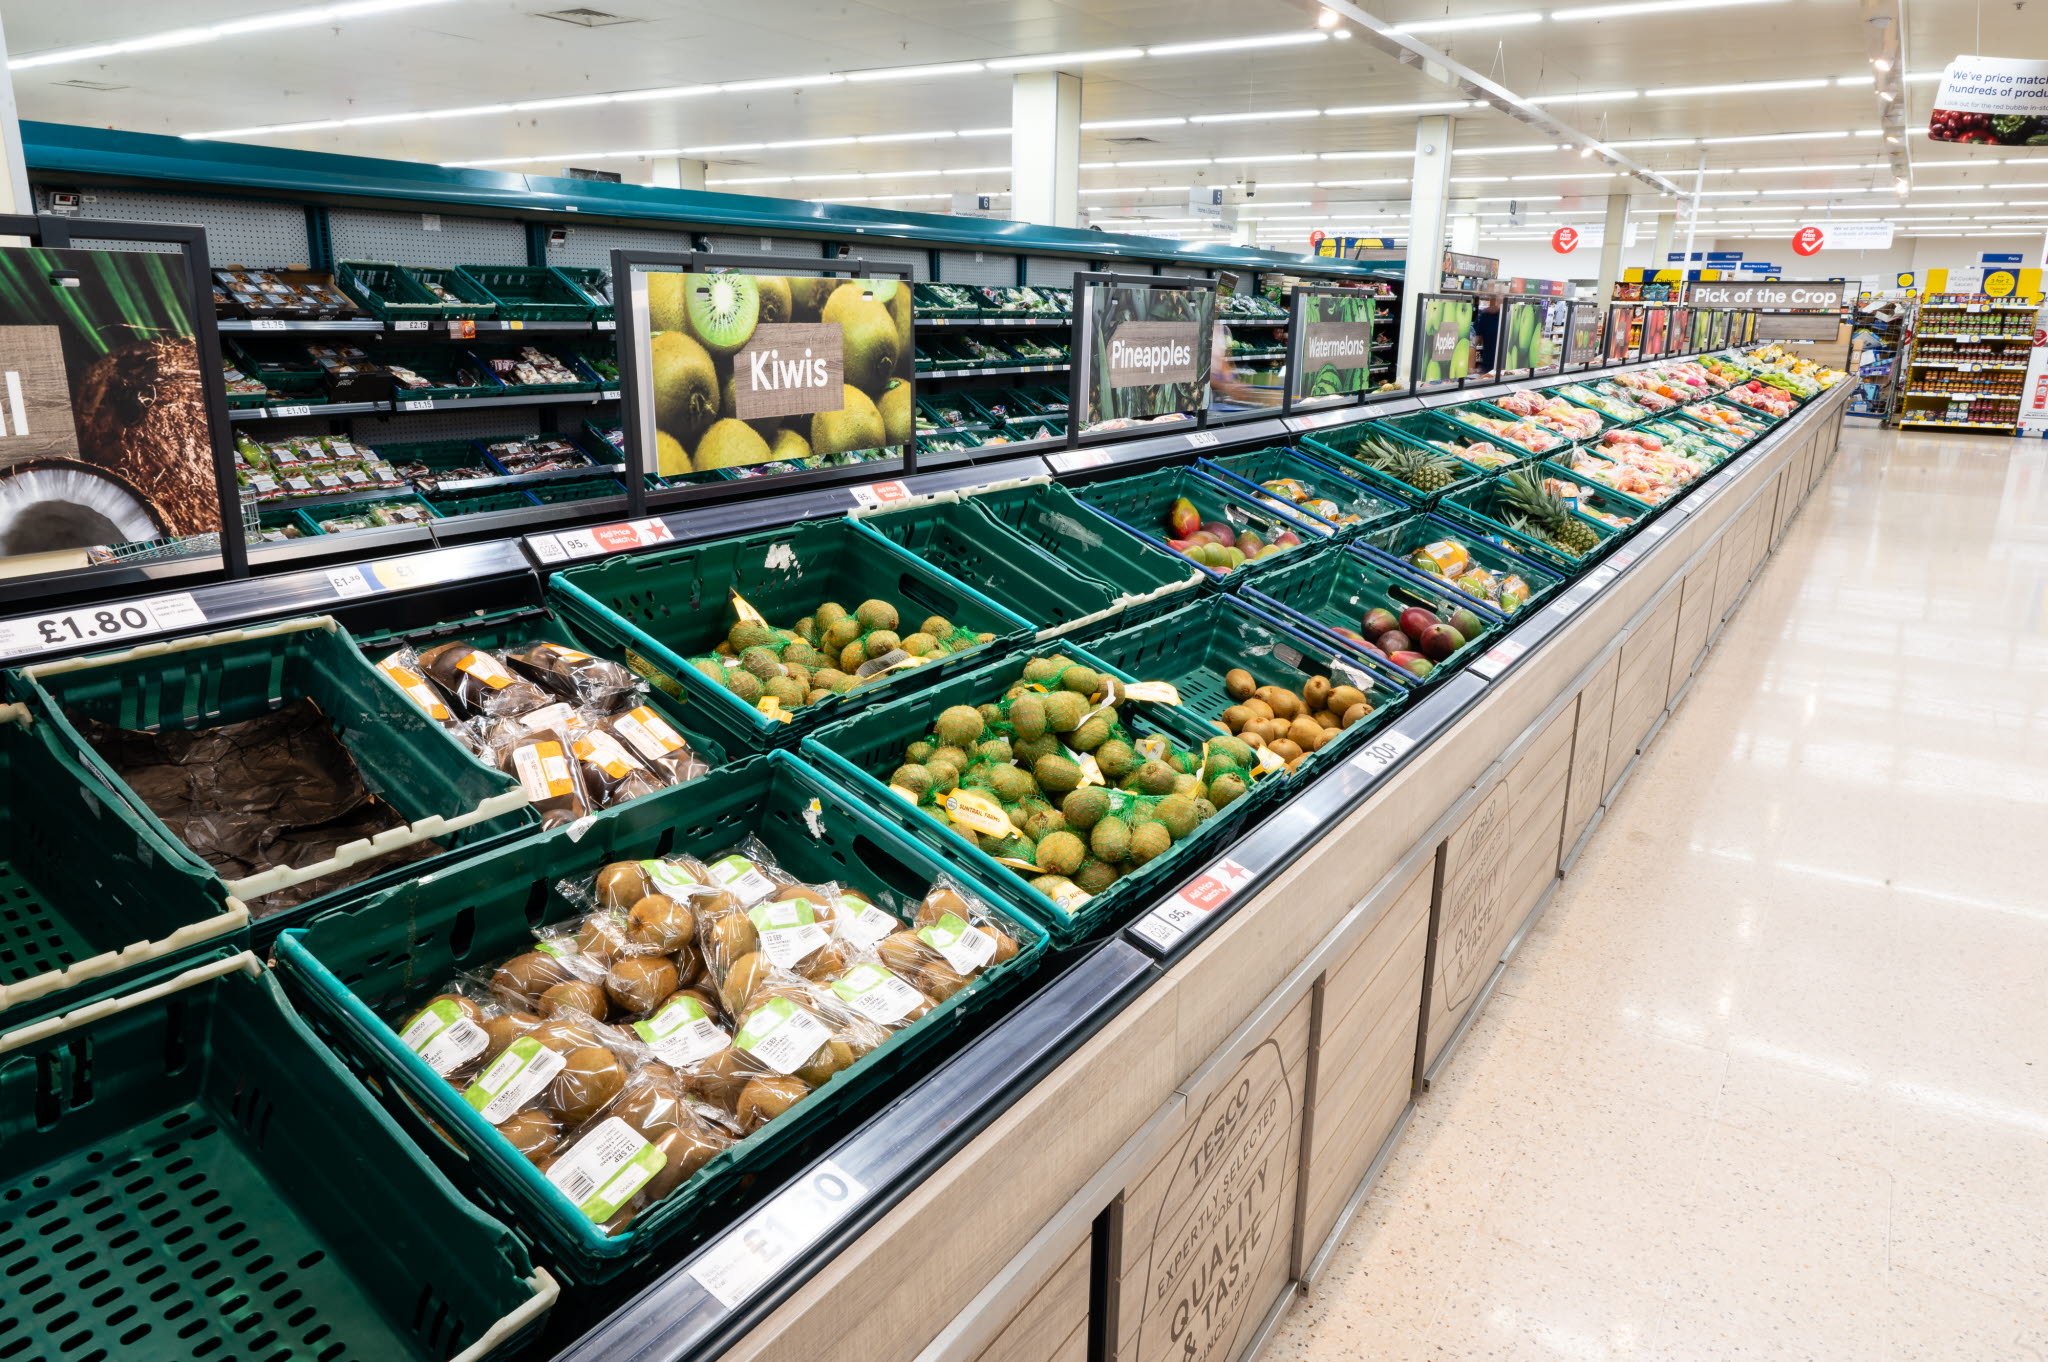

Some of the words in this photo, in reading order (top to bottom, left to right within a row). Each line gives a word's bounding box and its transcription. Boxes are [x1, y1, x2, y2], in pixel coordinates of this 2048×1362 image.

[1953, 70, 1982, 81] We've
[1984, 73, 2013, 84] price
[1948, 84, 1997, 96] hundreds
[2000, 88, 2012, 97] of
[1695, 288, 1731, 304] Pick
[1734, 288, 1753, 303] of
[1758, 289, 1787, 304] the
[1791, 290, 1837, 307] Crop
[1308, 335, 1364, 358] Watermelons
[1435, 333, 1456, 355] Apples
[1111, 339, 1191, 374] Pineapples
[750, 348, 829, 391] Kiwis
[286, 407, 309, 415] £1.10
[413, 400, 433, 409] £1.15
[567, 539, 589, 550] 95p
[599, 529, 613, 539] Aldi
[612, 528, 630, 538] Price
[609, 536, 631, 545] Match
[37, 607, 148, 644] £1.80
[1365, 742, 1399, 765] 30p
[984, 812, 1001, 823] FARMS
[1470, 799, 1496, 848] TESCO
[1199, 881, 1215, 892] Price
[1454, 863, 1498, 956] QUALITY
[1466, 898, 1494, 961] TASTE
[767, 1036, 778, 1046] SEP
[1188, 1078, 1250, 1179] TESCO
[613, 1150, 627, 1163] SEP
[626, 1143, 635, 1152] 12
[1157, 1191, 1219, 1300] EXPERTLY
[1223, 1099, 1277, 1194] SELECTED
[1212, 1192, 1233, 1234] FOR
[1170, 1158, 1269, 1344] QUALITY
[1183, 1331, 1198, 1362] &
[1202, 1210, 1262, 1331] TASTE
[1199, 1312, 1228, 1362] INCE
[1230, 1271, 1251, 1314] 1919
